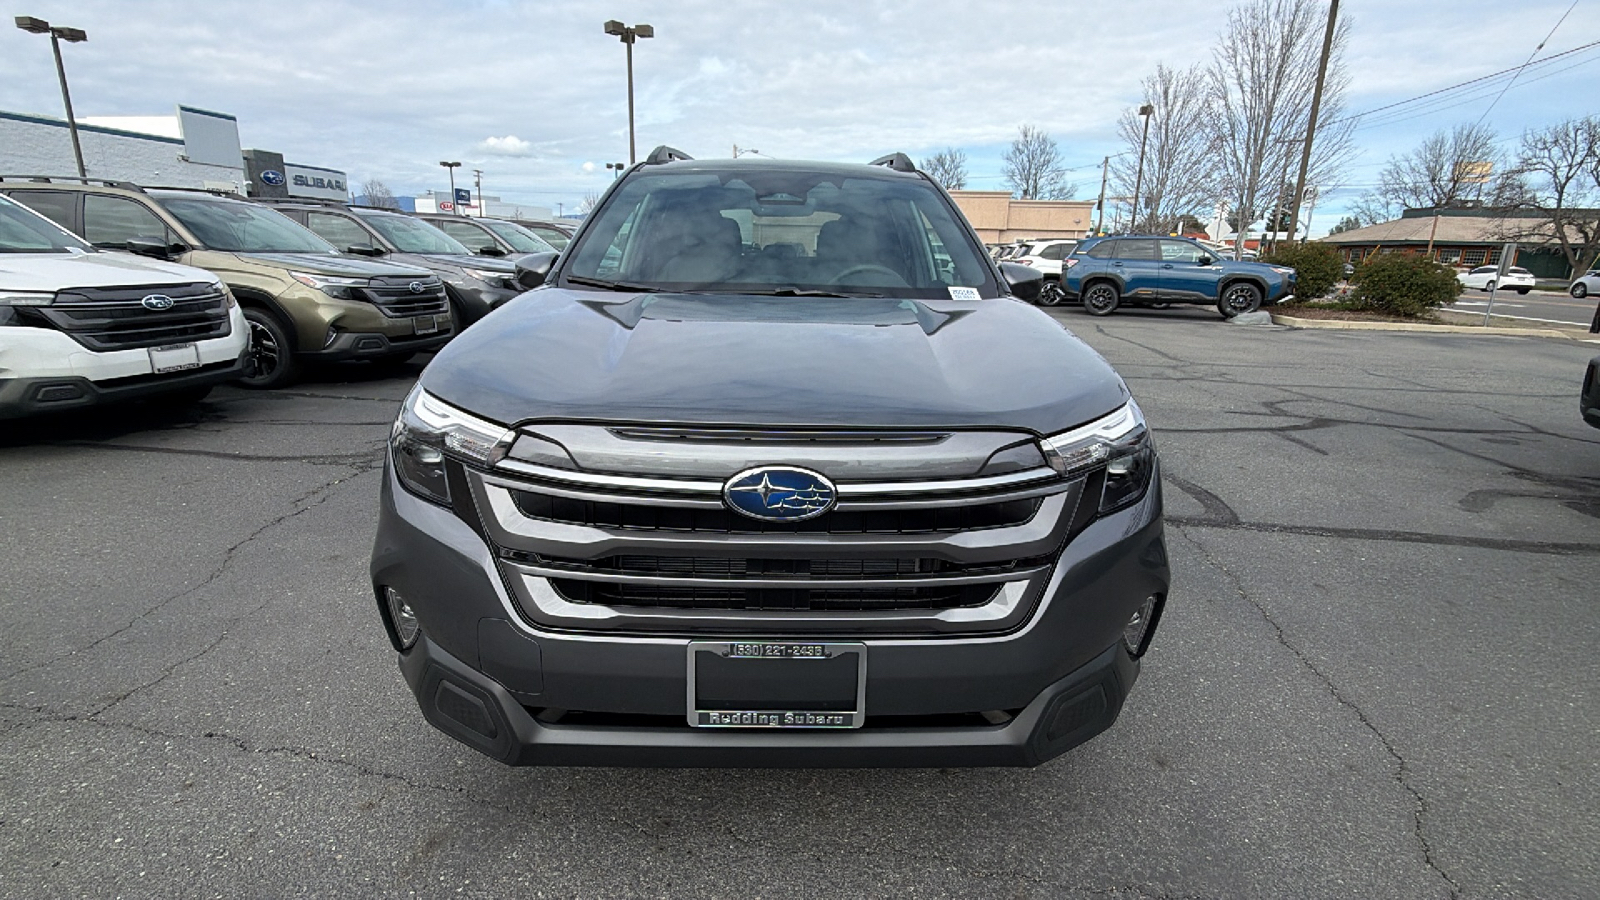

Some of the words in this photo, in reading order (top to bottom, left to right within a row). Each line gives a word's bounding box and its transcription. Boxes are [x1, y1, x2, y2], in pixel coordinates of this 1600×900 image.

[293, 174, 347, 192] SUBARU
[733, 643, 764, 656] (530)
[709, 712, 779, 726] Redding
[784, 712, 844, 725] Subaru
